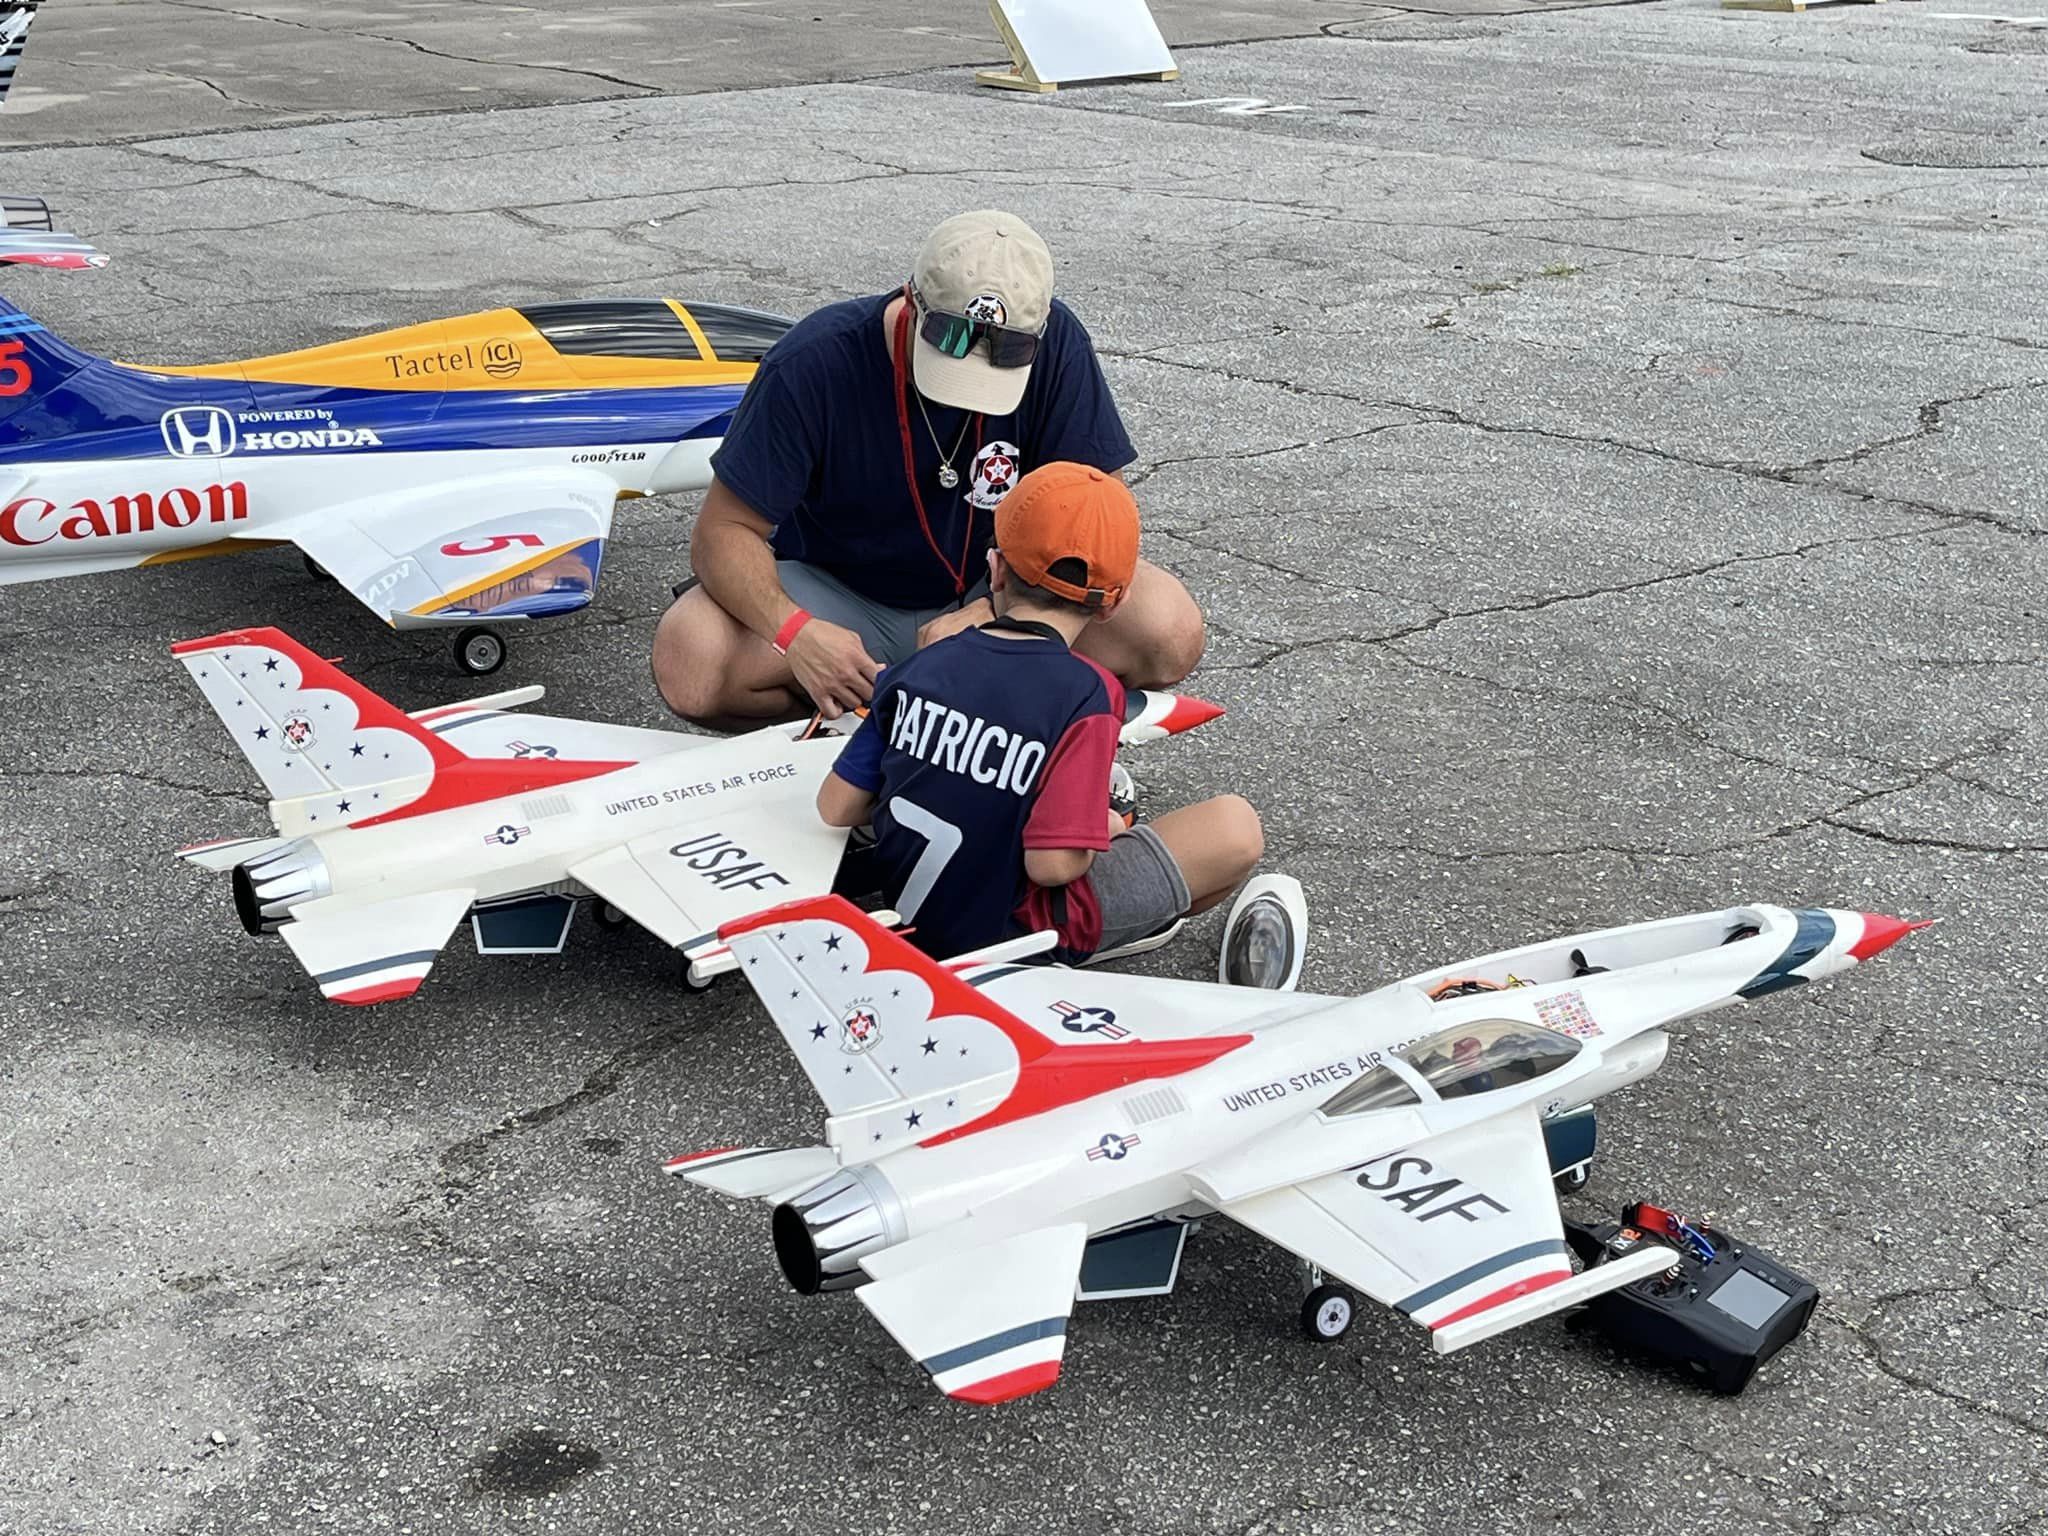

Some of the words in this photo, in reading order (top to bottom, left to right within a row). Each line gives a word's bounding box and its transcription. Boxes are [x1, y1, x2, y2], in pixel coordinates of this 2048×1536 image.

[385, 345, 474, 378] Tactel
[487, 343, 514, 362] ICI
[238, 410, 315, 423] POWERED
[317, 408, 333, 421] by
[243, 428, 383, 450] HONDA
[0, 481, 248, 546] Canon
[440, 534, 545, 557] 5
[606, 795, 659, 816] UNITED
[663, 782, 716, 803] STATES
[721, 776, 745, 791] AIR
[749, 763, 798, 783] FORCE
[669, 833, 791, 890] USAF
[889, 796, 963, 925] 7
[1223, 1082, 1287, 1112] UNITED
[1289, 1062, 1352, 1091] STATES
[1356, 1051, 1383, 1071] AIR
[1343, 1149, 1511, 1222] SAF
